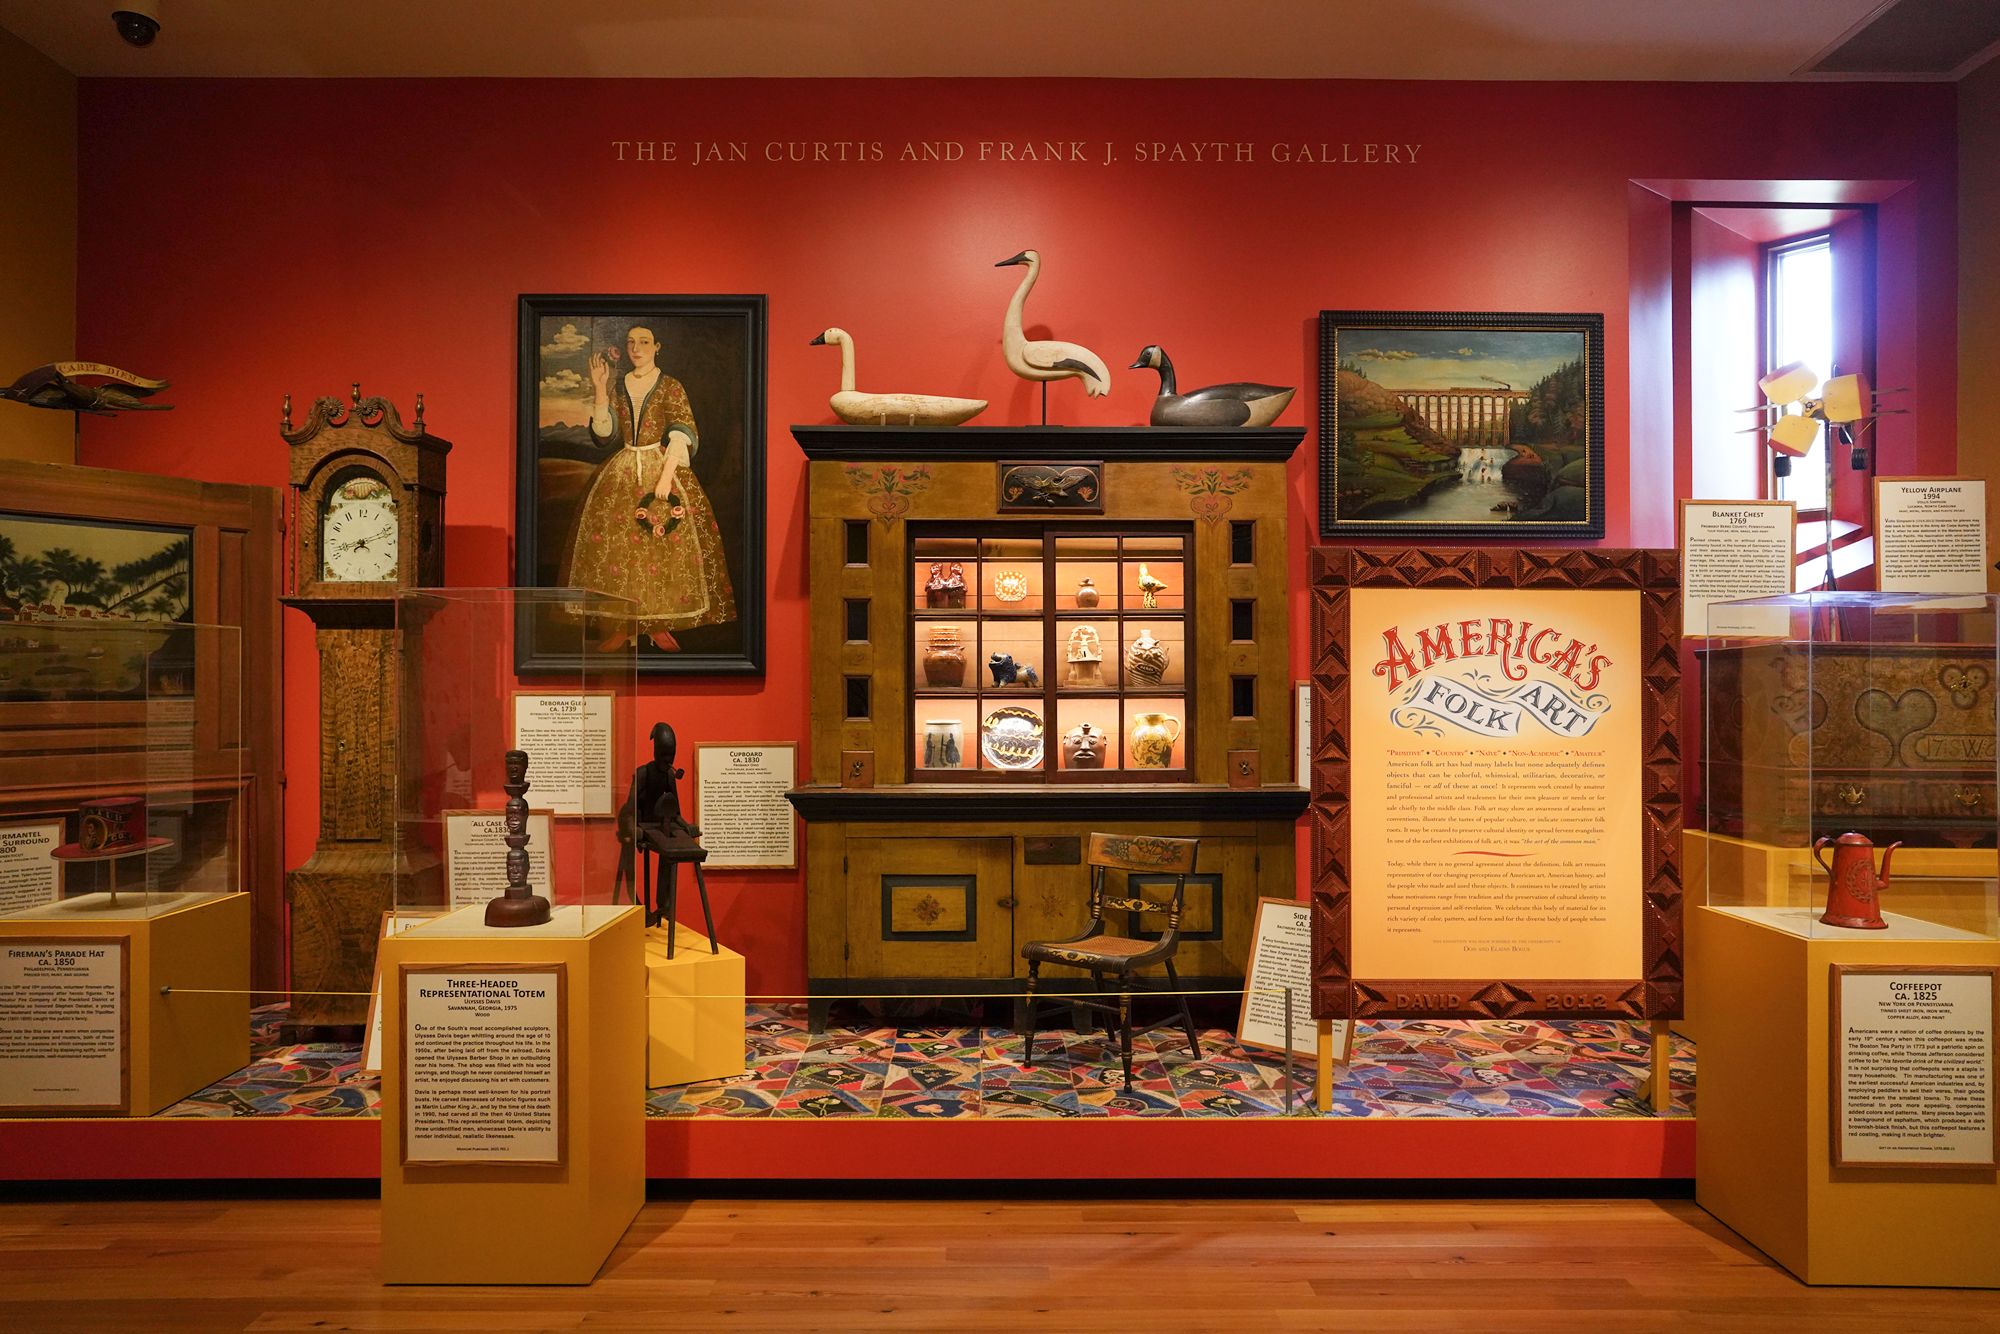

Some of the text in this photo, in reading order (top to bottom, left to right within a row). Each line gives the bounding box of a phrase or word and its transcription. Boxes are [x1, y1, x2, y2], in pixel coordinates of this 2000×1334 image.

[612, 141, 1421, 166] THE JAN CURTIS AND FRANK J. SPAYTH GALLERY
[1373, 618, 1613, 695] AMERICA'S
[1424, 681, 1587, 733] FOLK ART
[1545, 761, 1581, 769] adequately
[3, 838, 50, 846] SURROUND
[8, 949, 53, 958] FIREMAN'S
[55, 950, 87, 958] PARADE
[446, 979, 518, 988] THREE-HEADED
[1890, 982, 1942, 991] COFFEEPOT
[420, 989, 545, 998] REPRESENTATIONAL TOTEM
[1913, 992, 1938, 1001] 1825
[1396, 994, 1608, 1010] DAVID 2012
